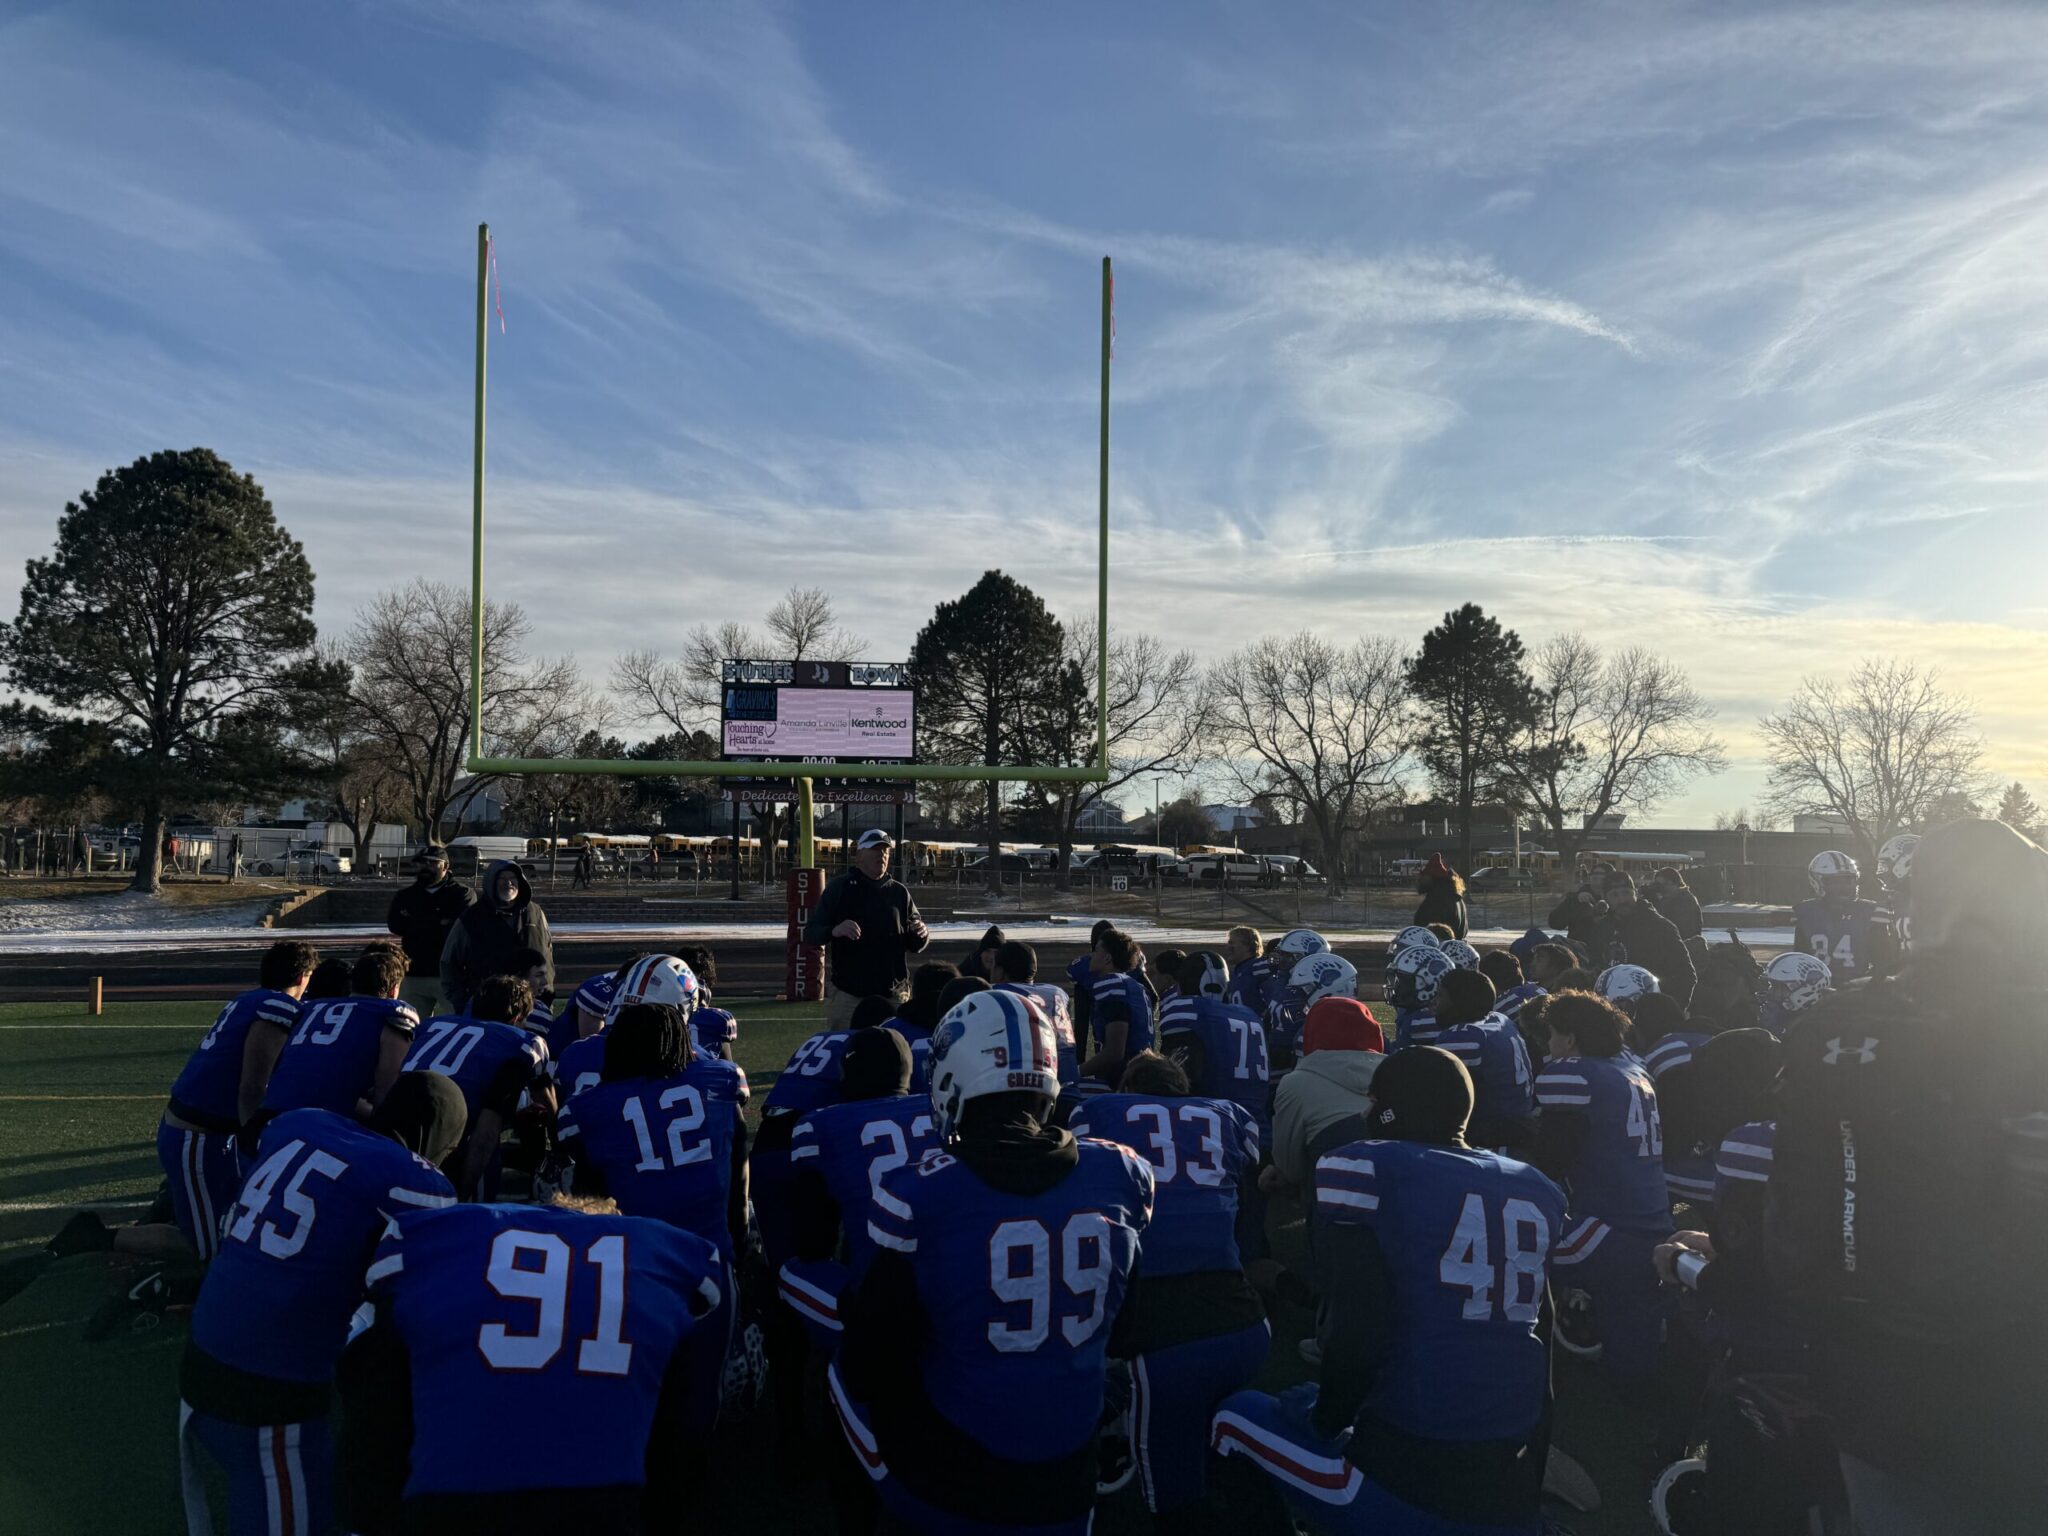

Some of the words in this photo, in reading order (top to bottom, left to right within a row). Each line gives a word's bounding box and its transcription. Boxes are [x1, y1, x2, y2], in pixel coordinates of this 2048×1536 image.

[724, 664, 794, 681] STUTLER
[853, 666, 906, 682] BOWL
[725, 720, 765, 736] Touching
[729, 733, 758, 746] Hearts
[780, 719, 817, 727] Amanda
[851, 718, 907, 728] Kentwood
[740, 790, 800, 801] Dedicate
[828, 790, 895, 802] Excellence
[1114, 881, 1126, 890] 10
[794, 872, 809, 998] STUTLER
[593, 980, 614, 994] 75
[290, 1002, 359, 1047] 19
[403, 1020, 486, 1076] 70
[1227, 1016, 1269, 1082] 73
[783, 1034, 849, 1077] 95
[994, 1046, 1008, 1068] 9
[622, 1084, 713, 1173] 12
[1125, 1104, 1224, 1186] 33
[1839, 1120, 1856, 1183] UNDER
[231, 1139, 348, 1260] 45
[1843, 1187, 1857, 1273] ARMOUR
[987, 1210, 1113, 1353] 99
[1440, 1193, 1550, 1323] 48
[478, 1229, 633, 1375] 91
